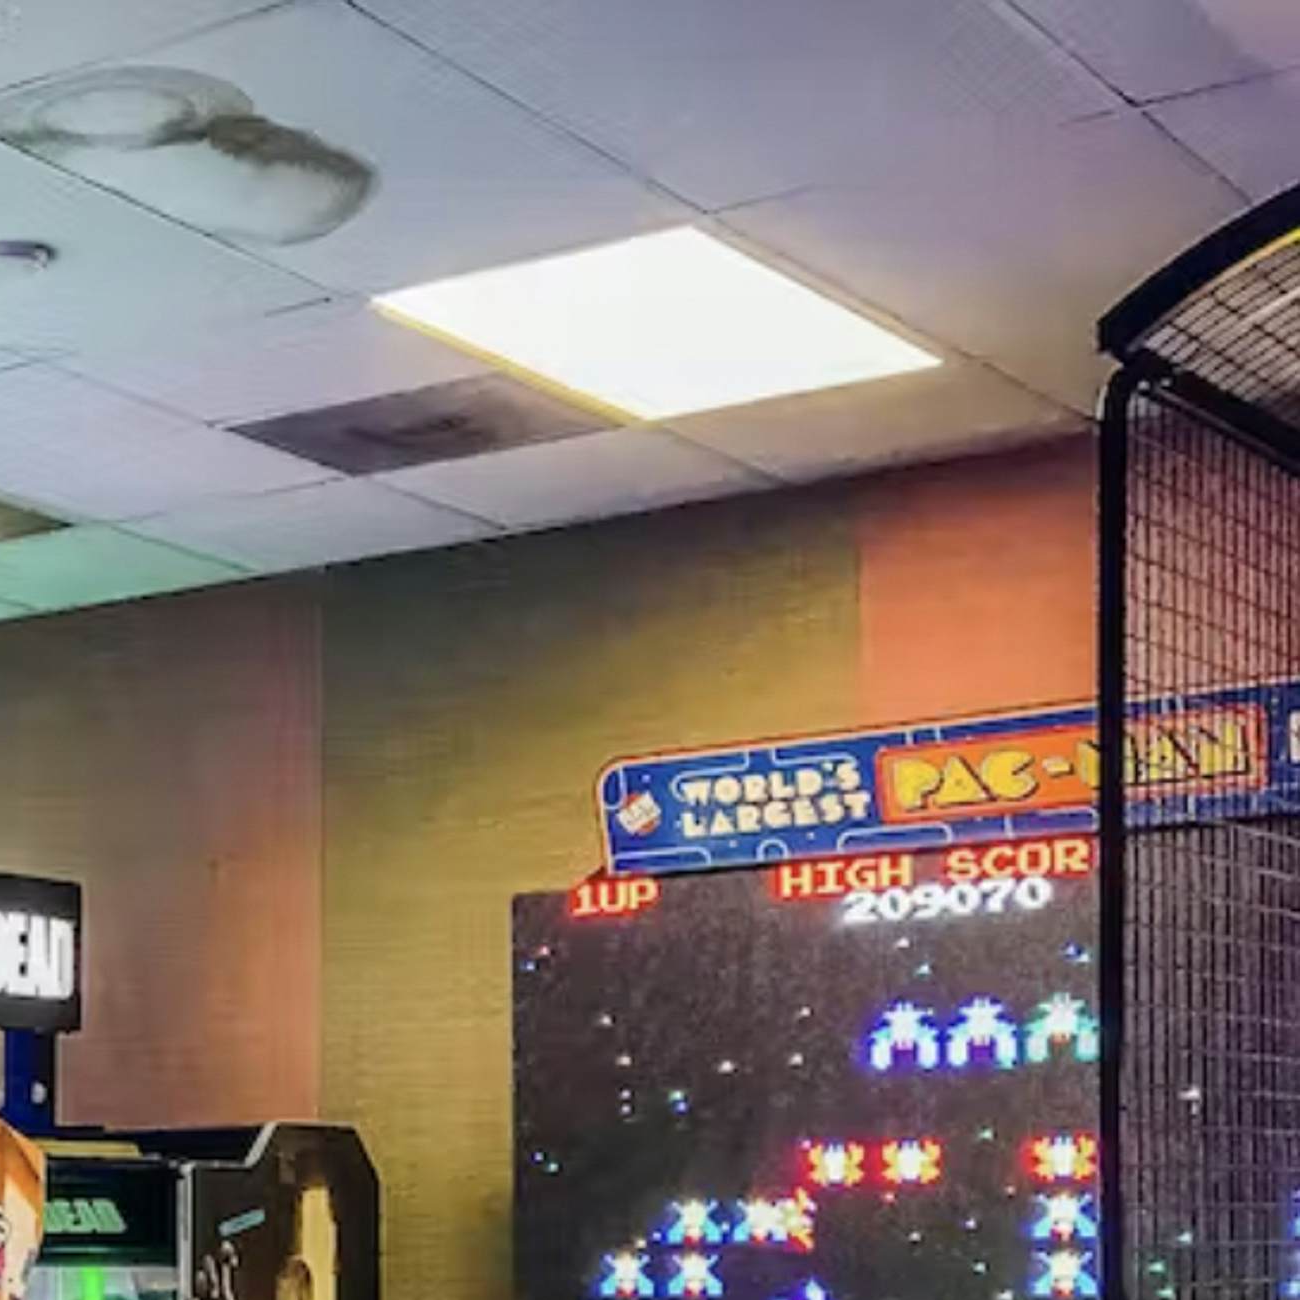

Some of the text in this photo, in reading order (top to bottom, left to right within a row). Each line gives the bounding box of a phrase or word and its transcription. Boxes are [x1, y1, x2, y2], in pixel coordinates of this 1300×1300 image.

[680, 762, 861, 806] WORLD'S
[680, 791, 871, 838] LARGEST
[782, 838, 1091, 898] HIGH SCOR
[572, 878, 658, 914] 1UP
[842, 876, 1054, 923] 209070
